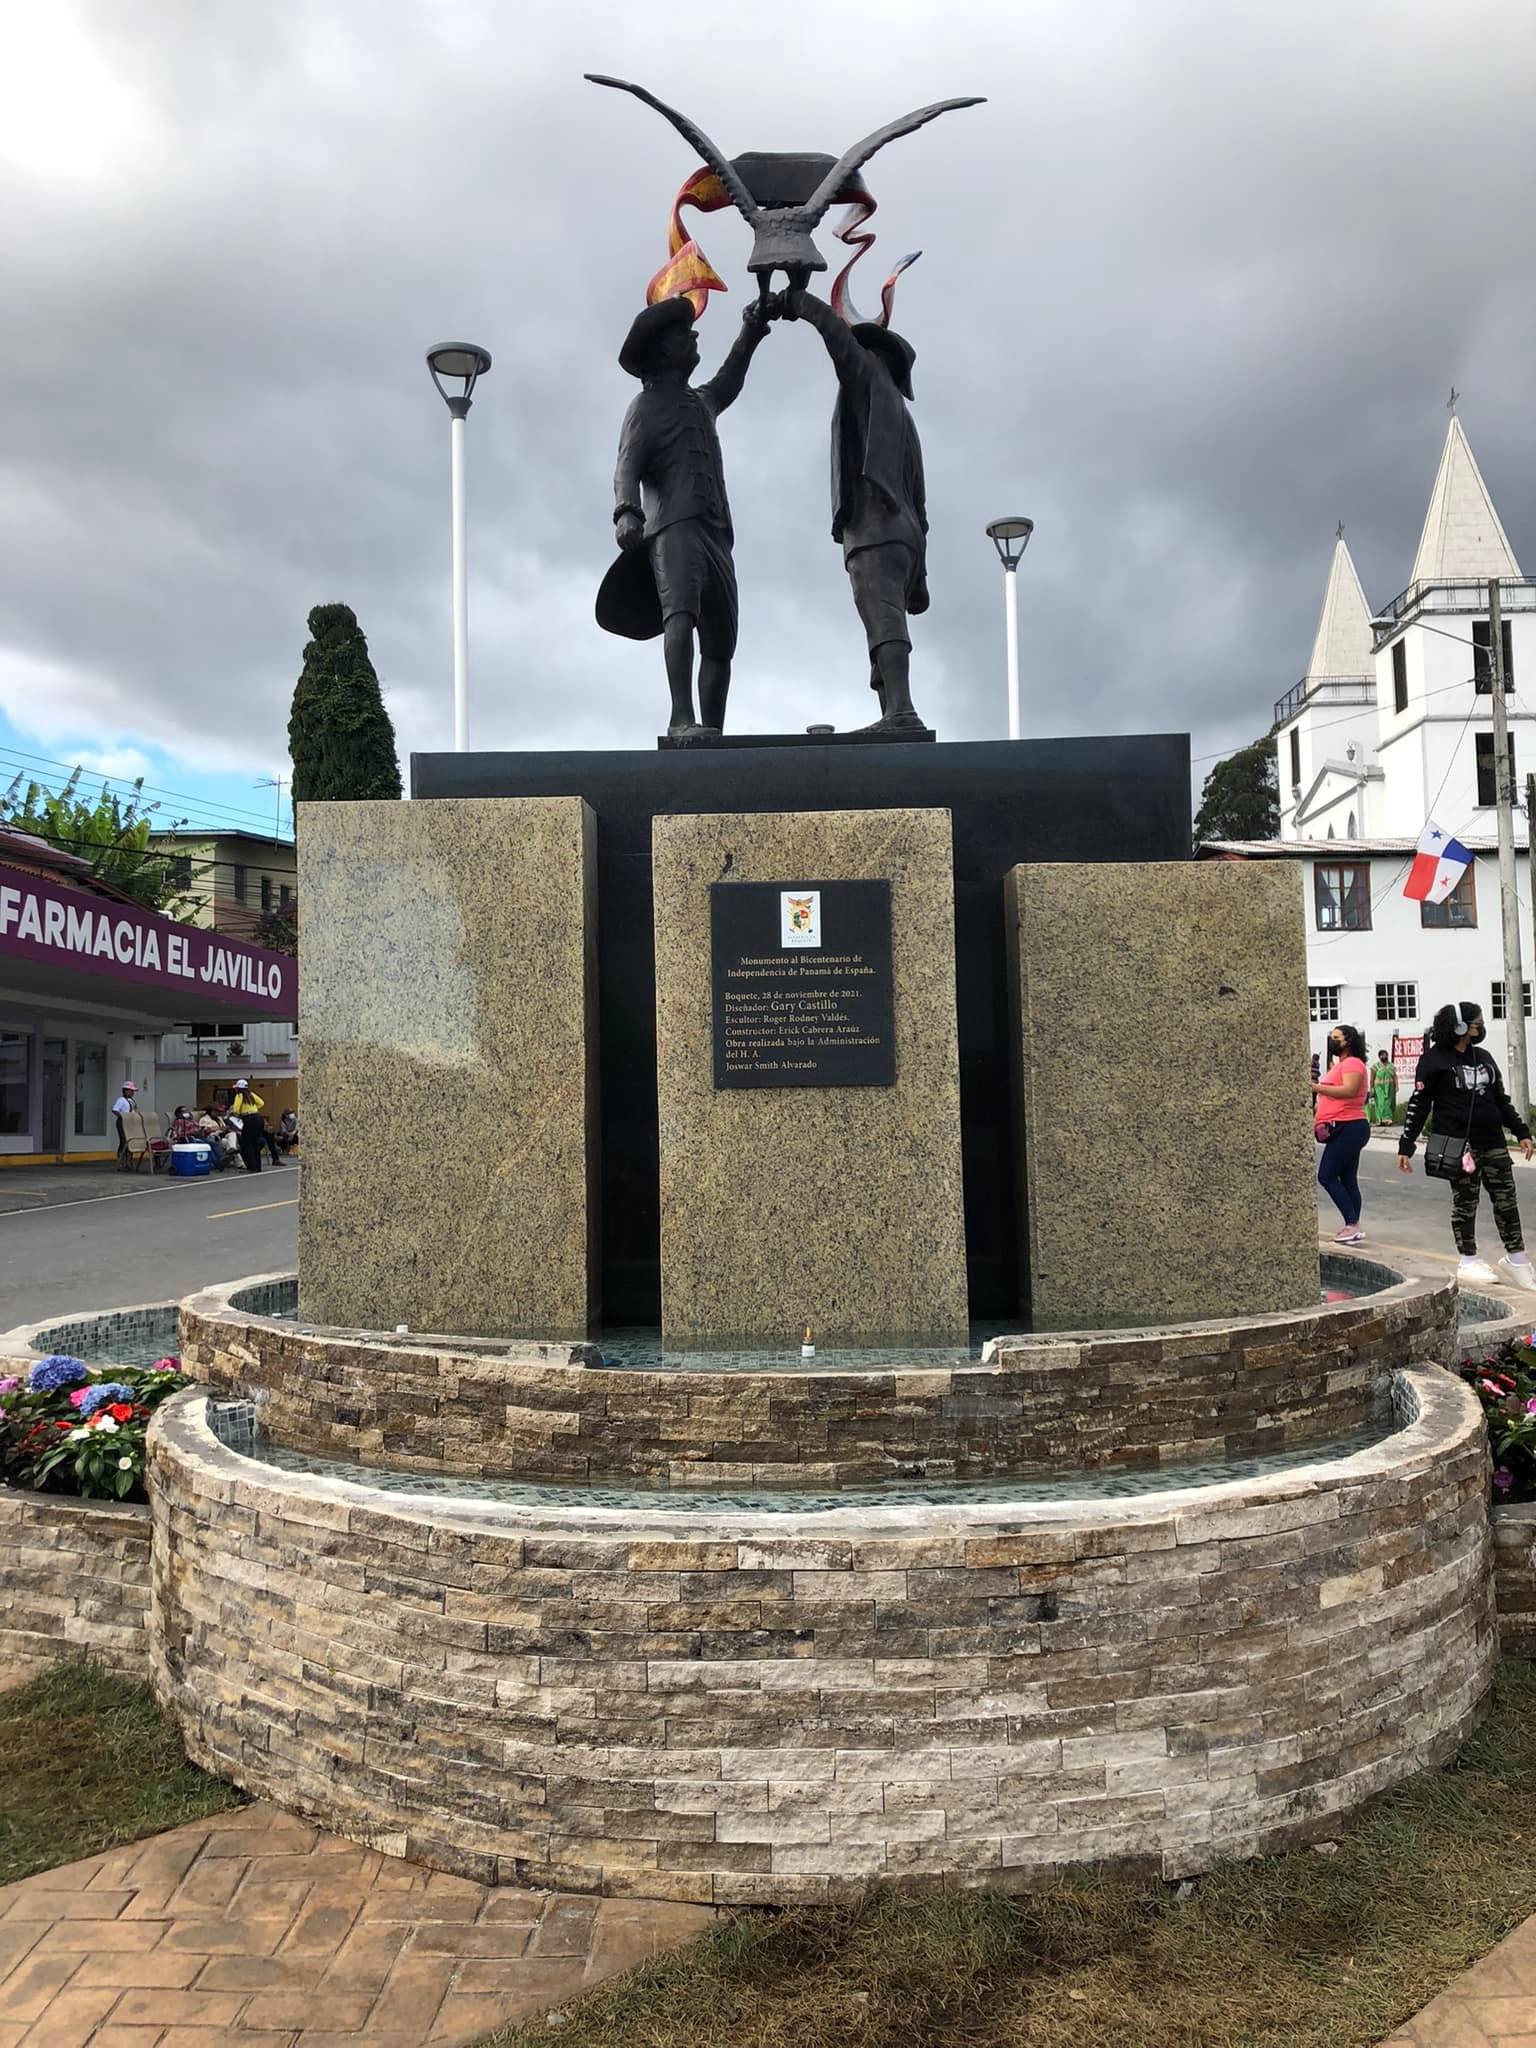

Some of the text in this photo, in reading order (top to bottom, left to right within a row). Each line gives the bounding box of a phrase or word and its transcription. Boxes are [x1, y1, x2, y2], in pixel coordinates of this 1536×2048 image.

[0, 885, 282, 999] FARMACIA EL JAVILLO
[741, 955, 863, 965] Monumento al Bicentenario de
[727, 966, 876, 979] Independencia de Panamá de España.
[725, 992, 760, 1002] Boquete,
[773, 991, 783, 999] de
[785, 990, 827, 999] noviembre
[829, 990, 839, 998] de
[841, 990, 862, 998] 2021.
[725, 999, 838, 1013] Diseñador: Gary Castillo
[725, 1012, 850, 1024] Escultor: Roger Rodney Valdés.
[725, 1025, 860, 1036] Constructor: Erick Cabrera Araúz
[725, 1035, 880, 1048] Obra realizada bajo la Administración
[726, 1050, 761, 1058] del H. A.
[726, 1060, 817, 1071] Joswar Smith Alvarado
